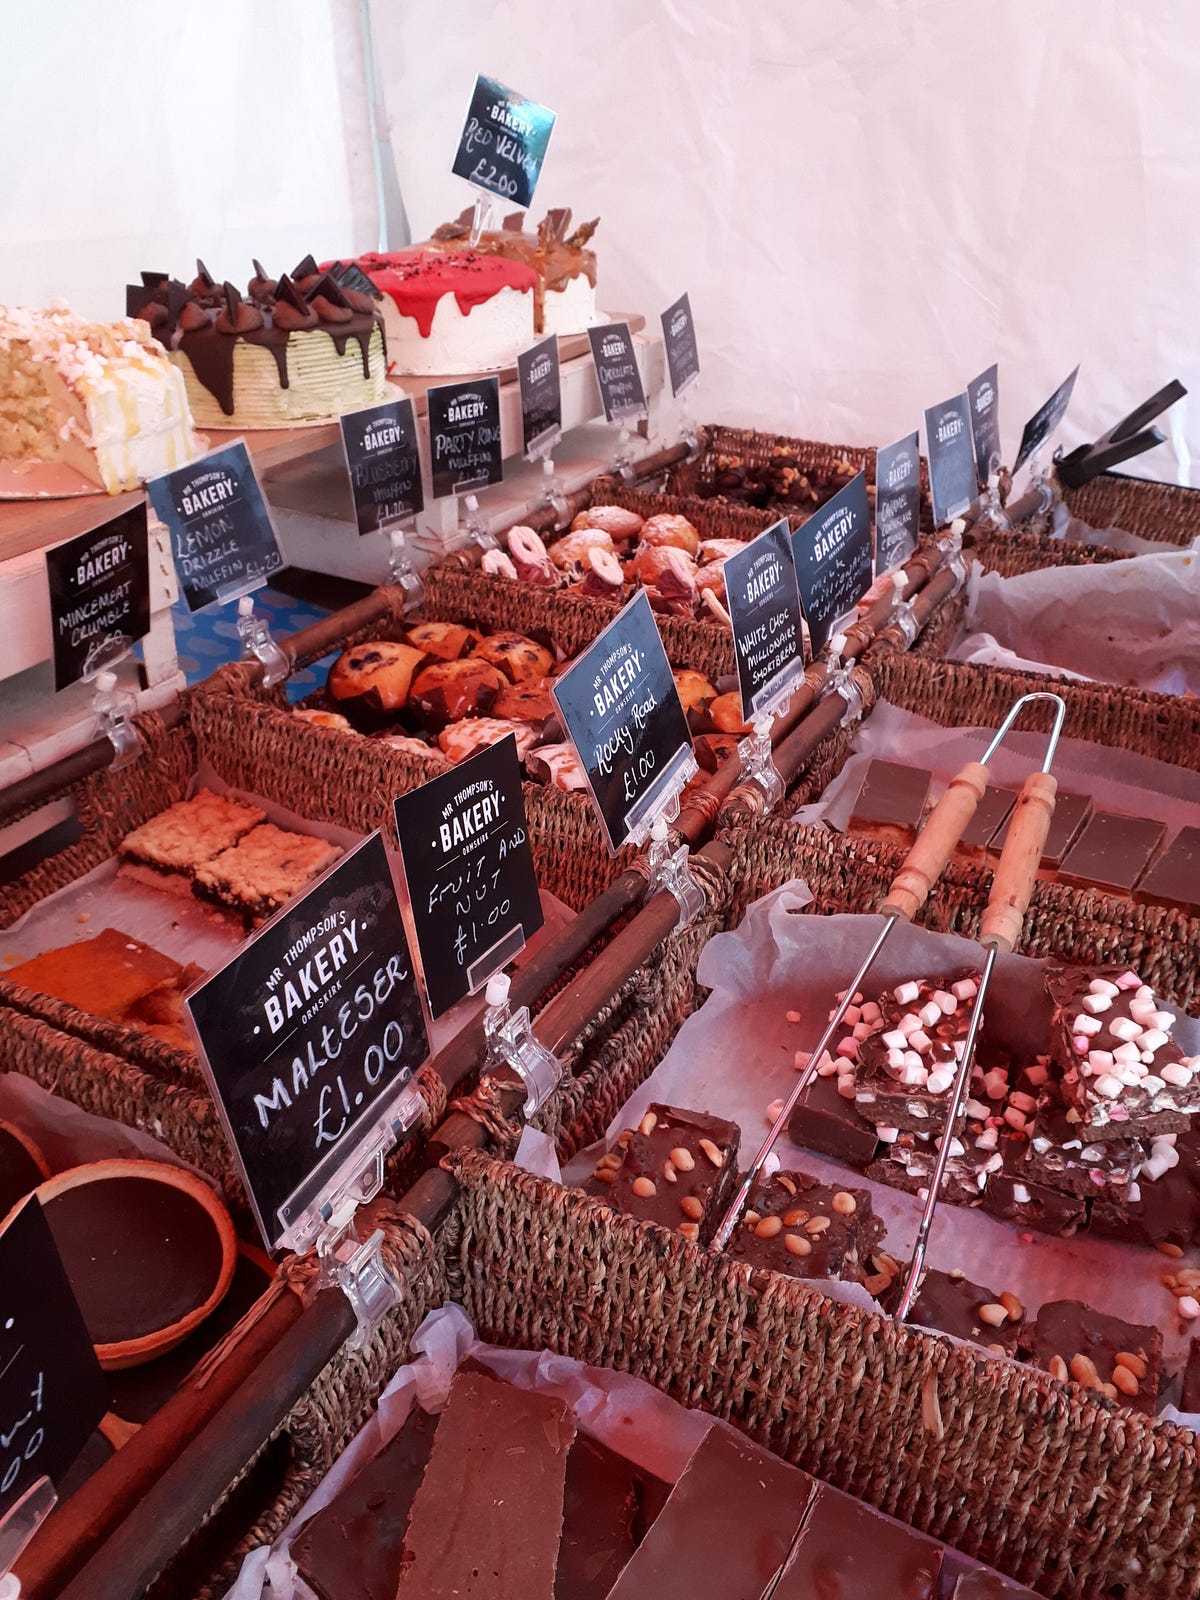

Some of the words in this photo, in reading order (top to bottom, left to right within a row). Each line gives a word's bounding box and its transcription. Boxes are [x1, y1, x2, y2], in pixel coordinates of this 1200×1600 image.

[465, 117, 493, 153] RED
[491, 105, 533, 136] BAKERY
[448, 402, 485, 422] BAKERY
[938, 418, 962, 442] BAKERY
[364, 426, 401, 451] BAKERY
[435, 430, 475, 460] PARTY
[448, 451, 492, 469] MUFFIN
[889, 461, 911, 487] BAKERY
[181, 478, 234, 516] BAKERY
[177, 514, 234, 558] LEMON
[182, 539, 240, 576] DRIZZLE
[813, 511, 854, 563] BAKERY
[77, 541, 128, 586] BAKERY
[192, 560, 243, 591] MUFFIN
[246, 552, 281, 580] £1.20
[746, 561, 780, 604] BAKERY
[58, 580, 132, 636] MINCEMEAT
[71, 600, 130, 648] CRUMBLE
[738, 625, 767, 658] WHITE
[769, 608, 790, 634] CHOC
[747, 624, 796, 672] MILLIONAIRE
[592, 676, 603, 691] MR
[600, 642, 632, 675] THOMPSON'S
[593, 649, 643, 717] BAKERY
[752, 643, 797, 685] SHORTBREAD
[615, 689, 636, 714] ORMSKIRK
[631, 688, 658, 729] Road
[624, 749, 656, 802] £1.00
[439, 790, 501, 853] BAKERY
[442, 803, 454, 820] MR
[453, 779, 494, 805] THOMPSON'S
[462, 833, 489, 856] ORMSKIRK
[456, 869, 500, 915] NUT
[266, 967, 284, 992] MR
[283, 910, 347, 967] THOMPSON'S
[454, 899, 510, 965] £1.00
[263, 918, 361, 1034] BAKERY
[301, 979, 343, 1025] ORMSKIRK
[254, 954, 407, 1129] MALTESER
[313, 1020, 404, 1150] £1.00
